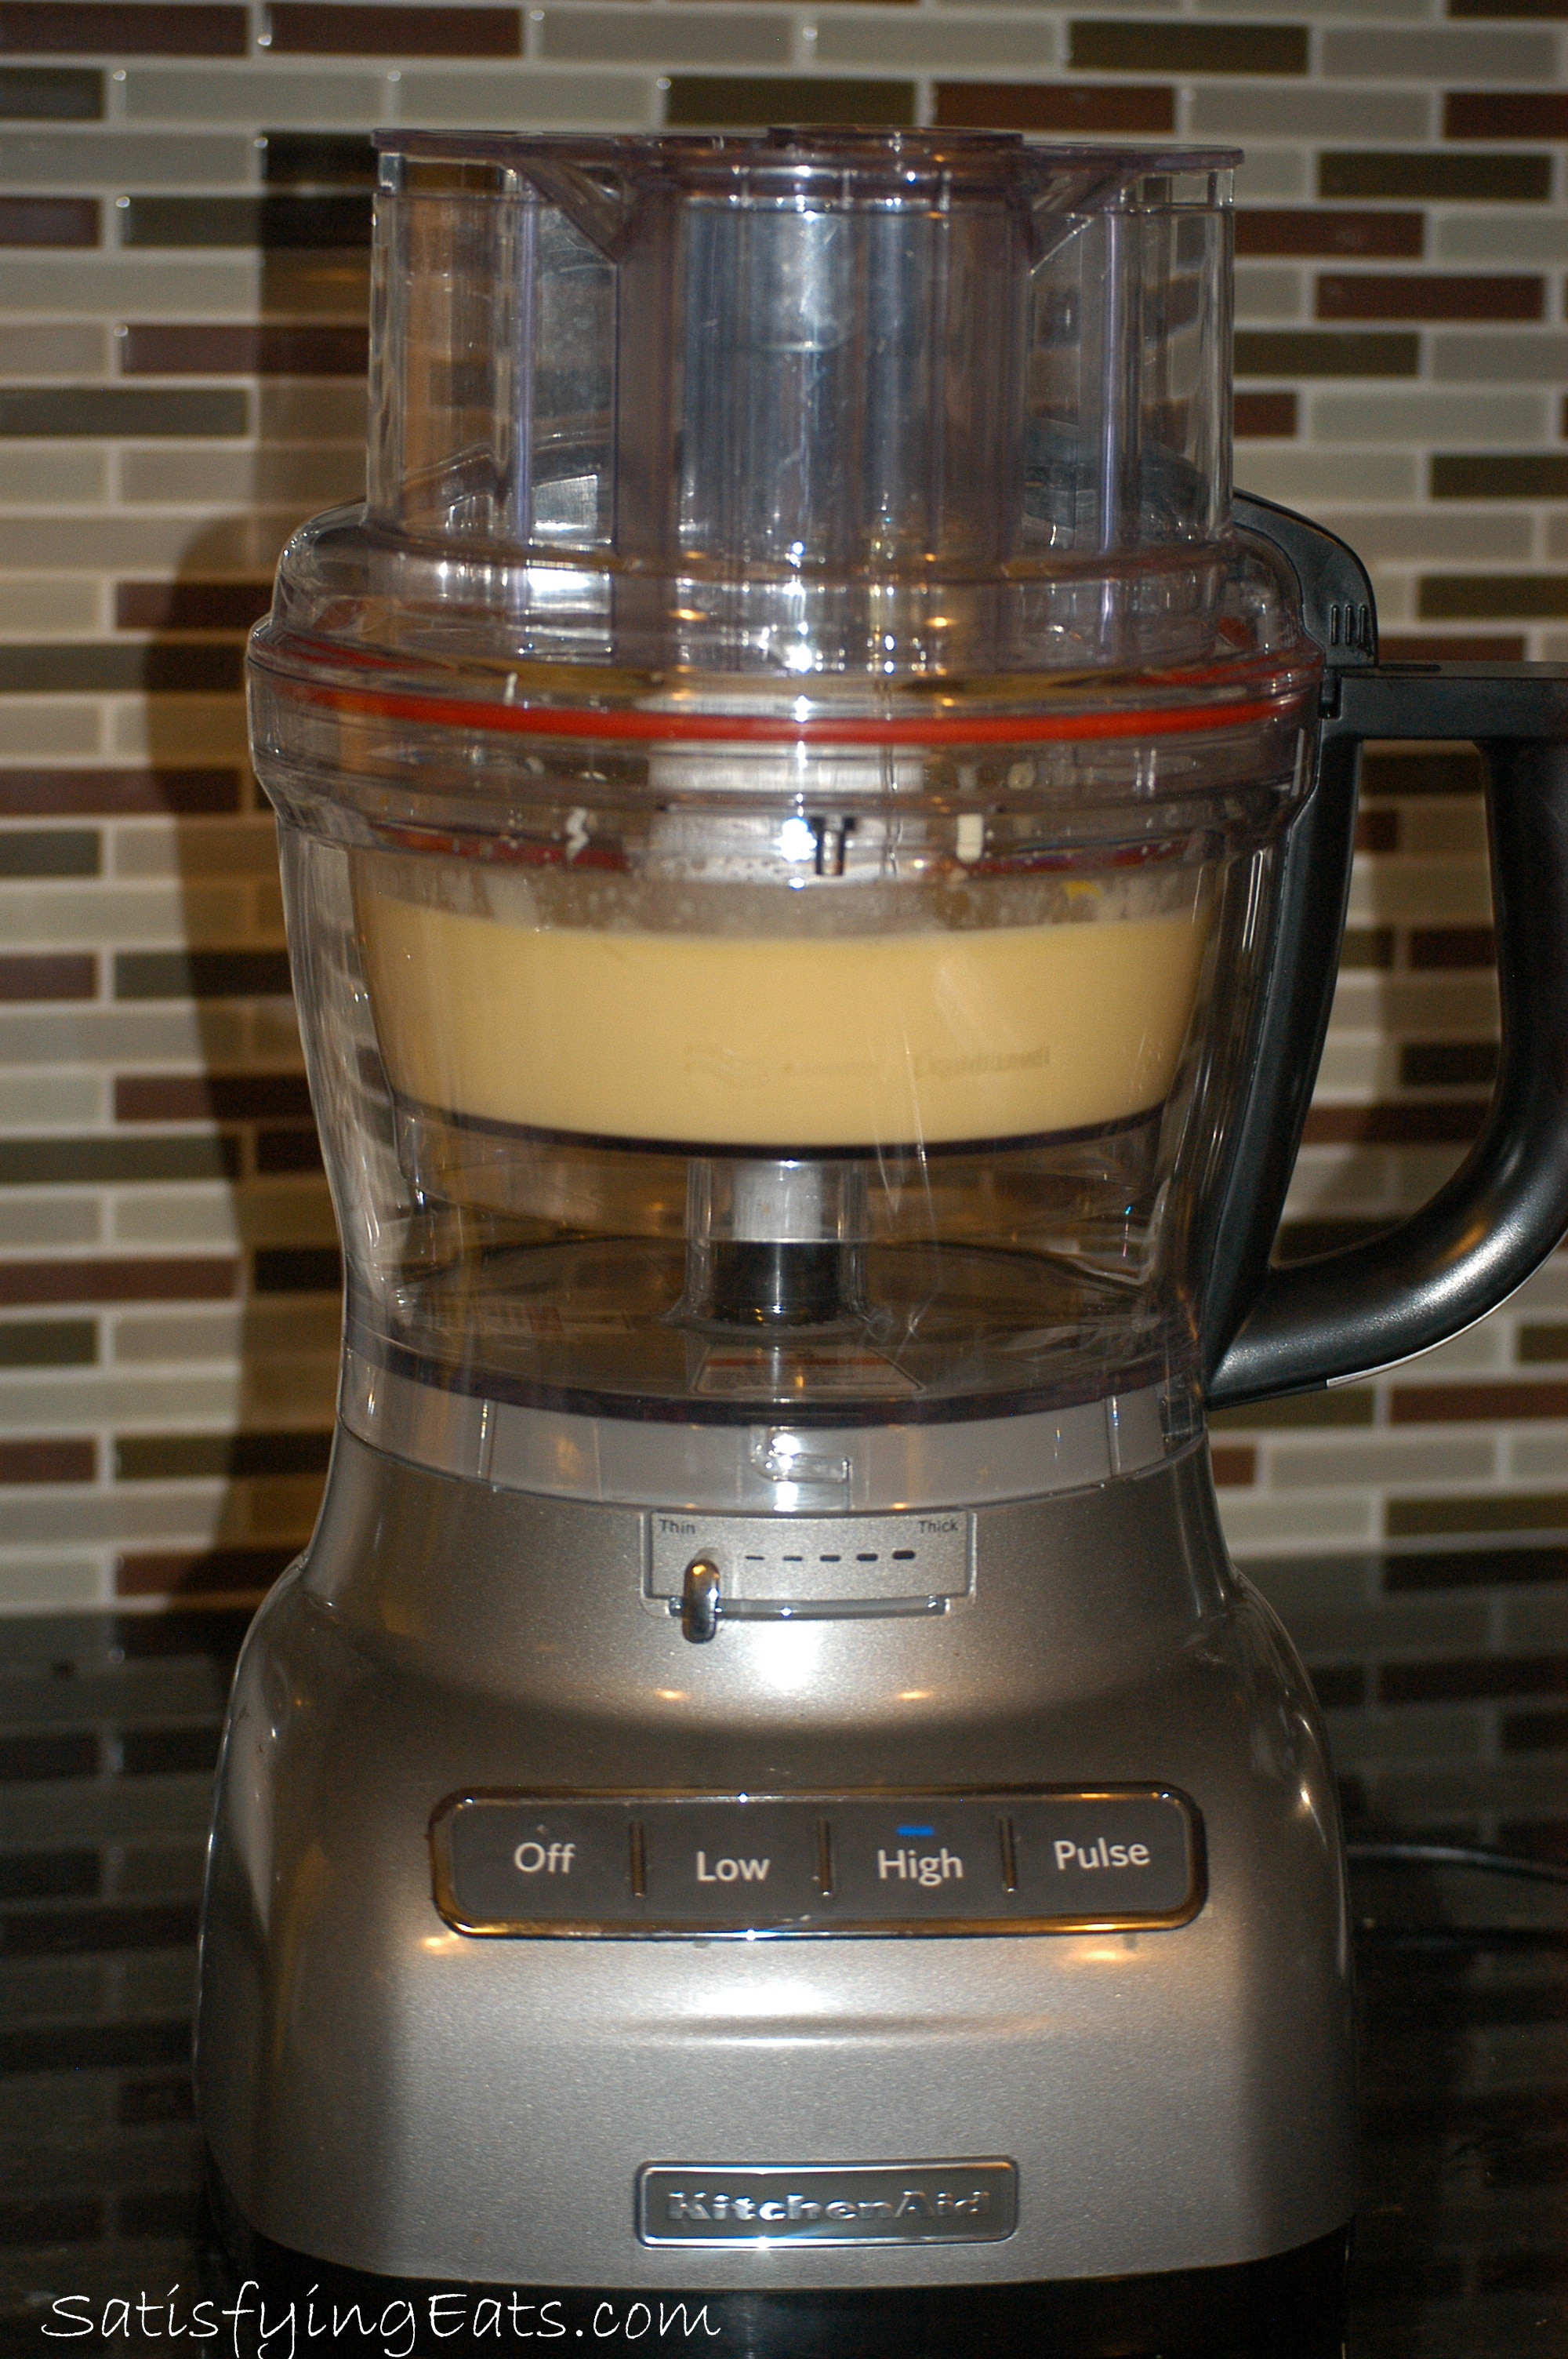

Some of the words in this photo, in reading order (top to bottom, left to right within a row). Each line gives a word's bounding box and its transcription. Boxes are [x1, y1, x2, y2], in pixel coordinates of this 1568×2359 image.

[659, 1518, 695, 1535] Thin
[918, 1518, 959, 1534] Thick
[514, 1841, 576, 1874] Off
[695, 1851, 771, 1881] Low
[877, 1848, 964, 1887] High
[1054, 1837, 1151, 1870] Pulse
[668, 2190, 989, 2221] KitchenAid
